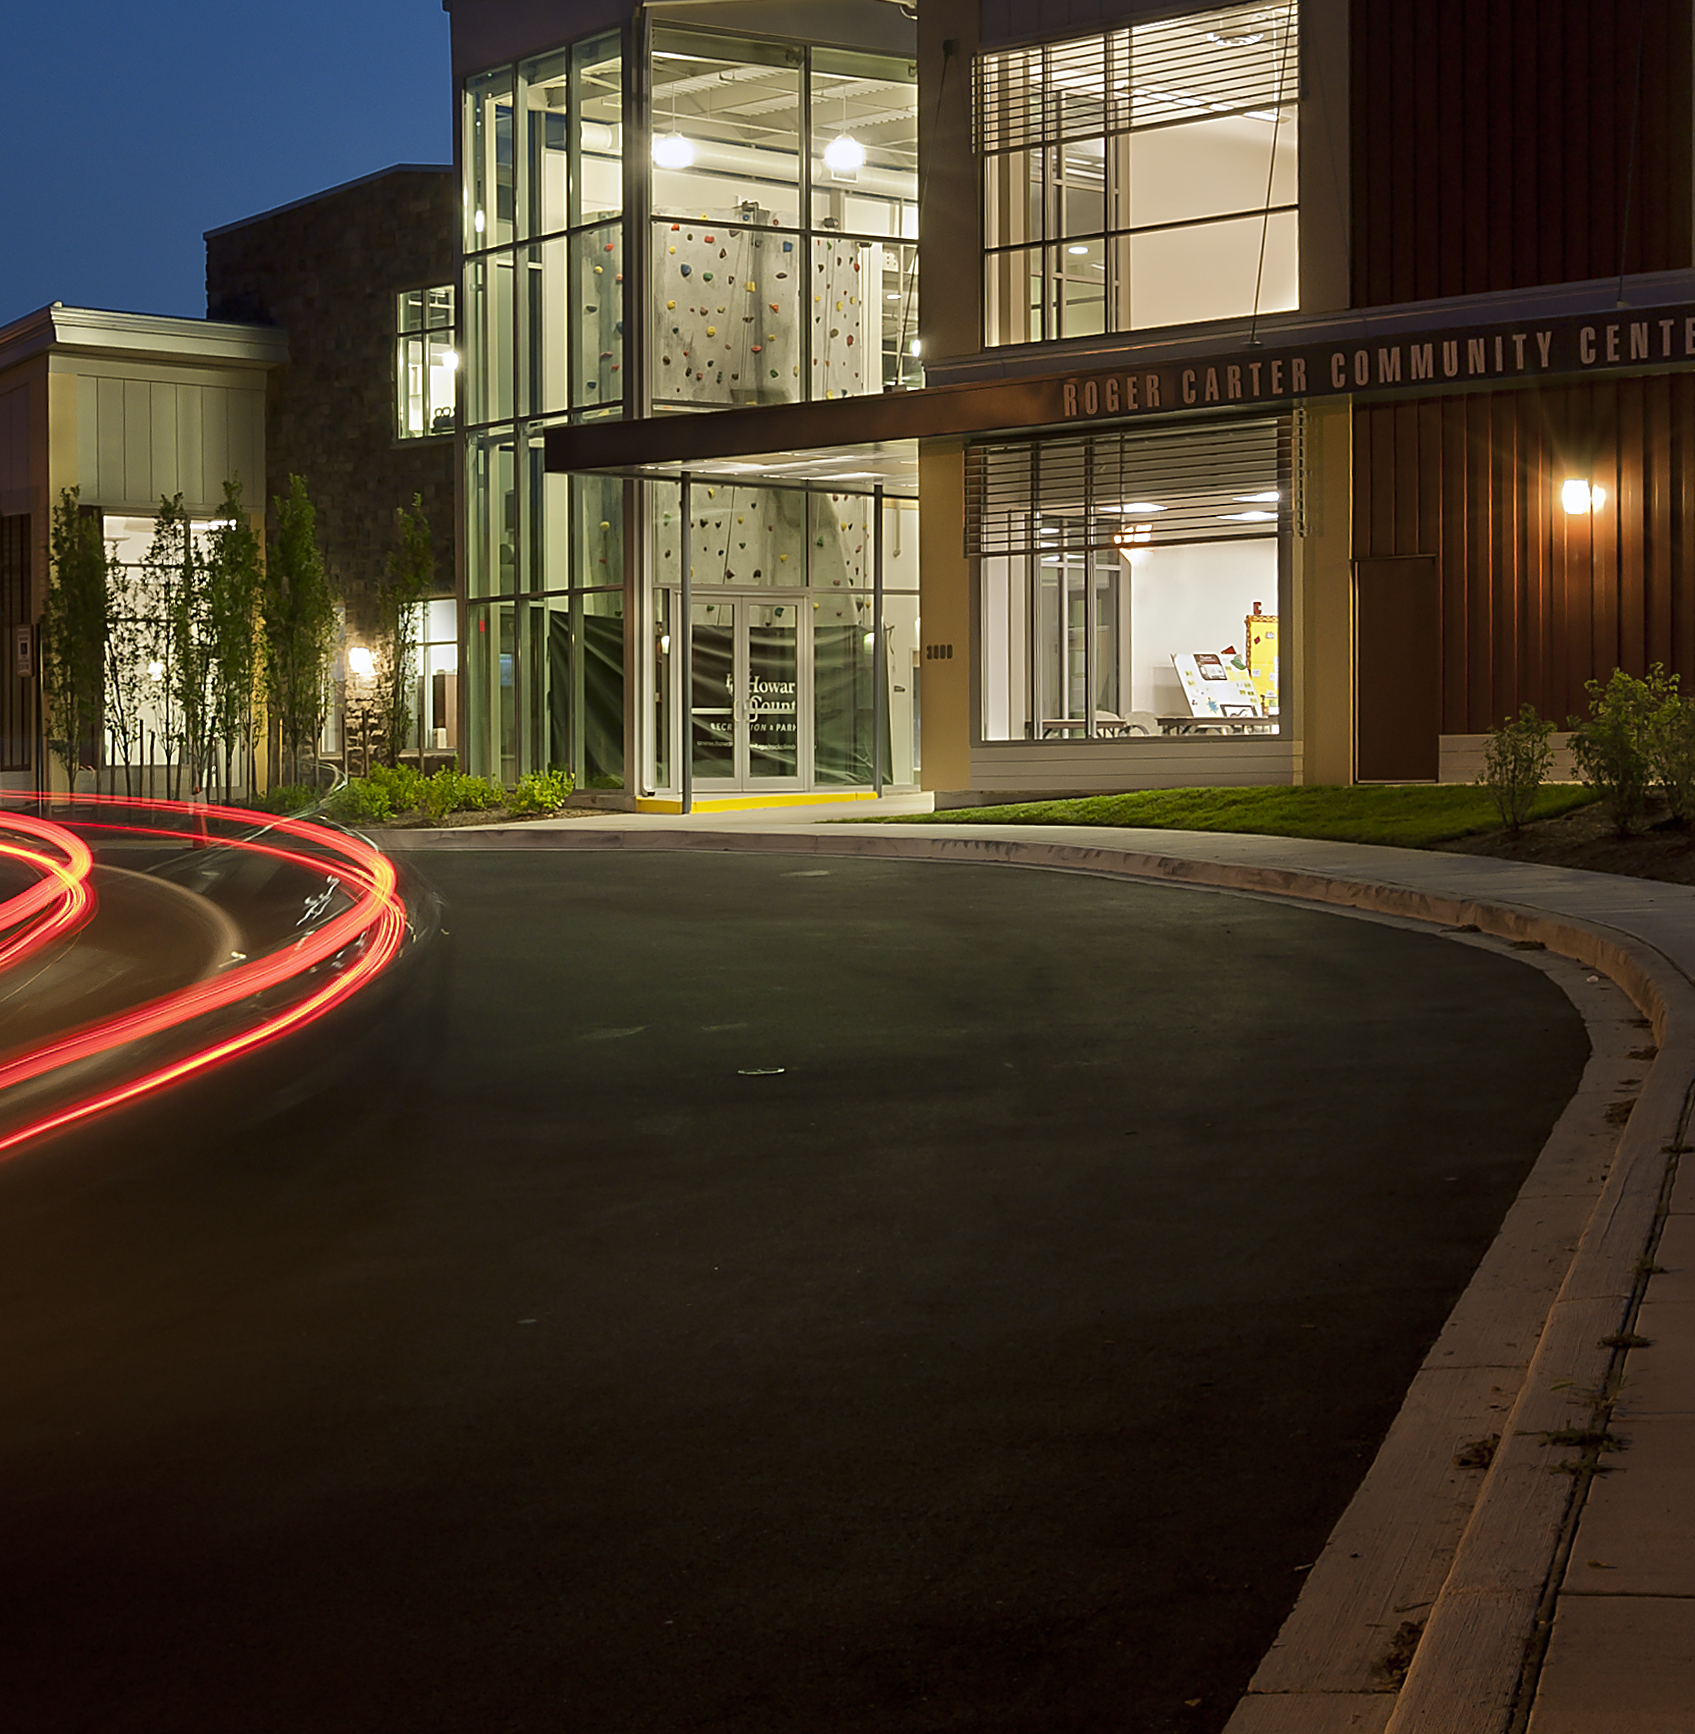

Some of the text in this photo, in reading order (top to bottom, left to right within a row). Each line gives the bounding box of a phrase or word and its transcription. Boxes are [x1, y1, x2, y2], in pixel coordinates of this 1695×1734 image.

[1063, 374, 1161, 417] ROGER
[1182, 358, 1308, 405] CARTER
[1330, 330, 1553, 389] COMMUNITY
[748, 675, 796, 694] Howar
[749, 695, 796, 712] Count
